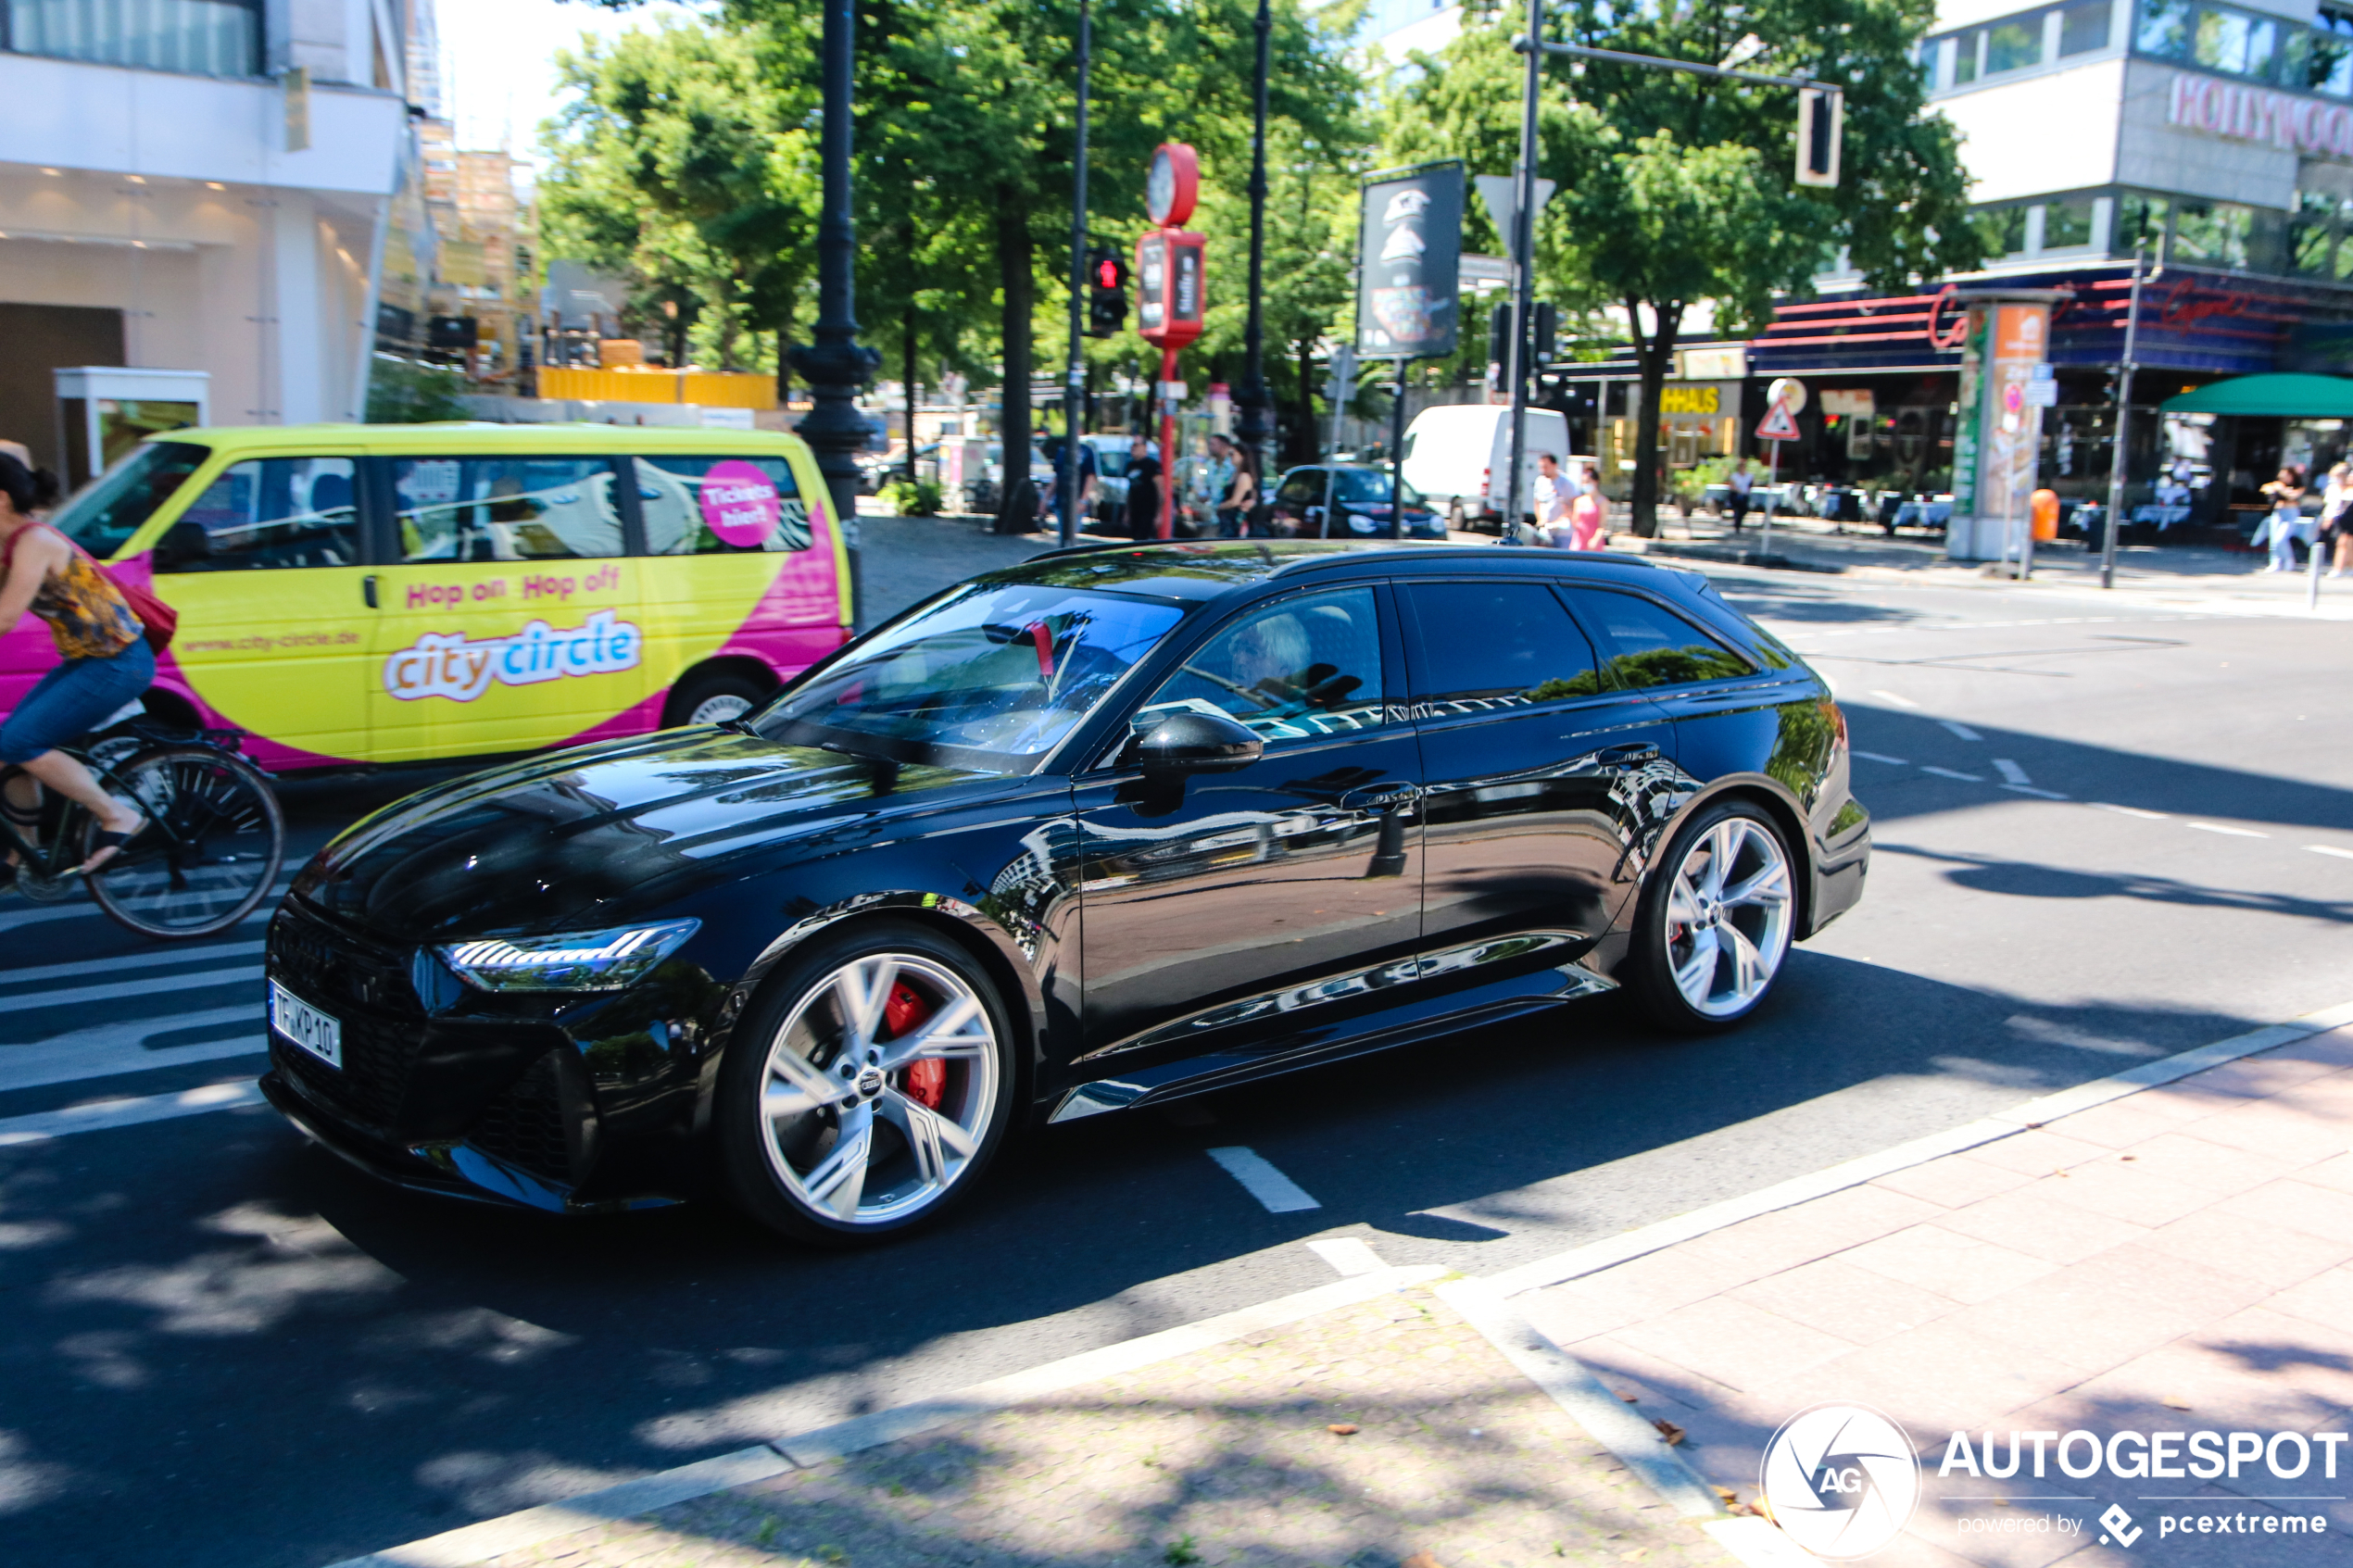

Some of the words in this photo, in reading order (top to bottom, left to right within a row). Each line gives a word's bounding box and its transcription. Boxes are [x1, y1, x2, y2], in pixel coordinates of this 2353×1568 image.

[2168, 72, 2353, 156] HOLLYWOO
[703, 483, 774, 506] Tickets
[721, 506, 767, 528] hier!
[406, 583, 463, 609] Hop
[472, 579, 506, 602] on
[522, 574, 576, 601] Hop
[584, 563, 621, 592] off
